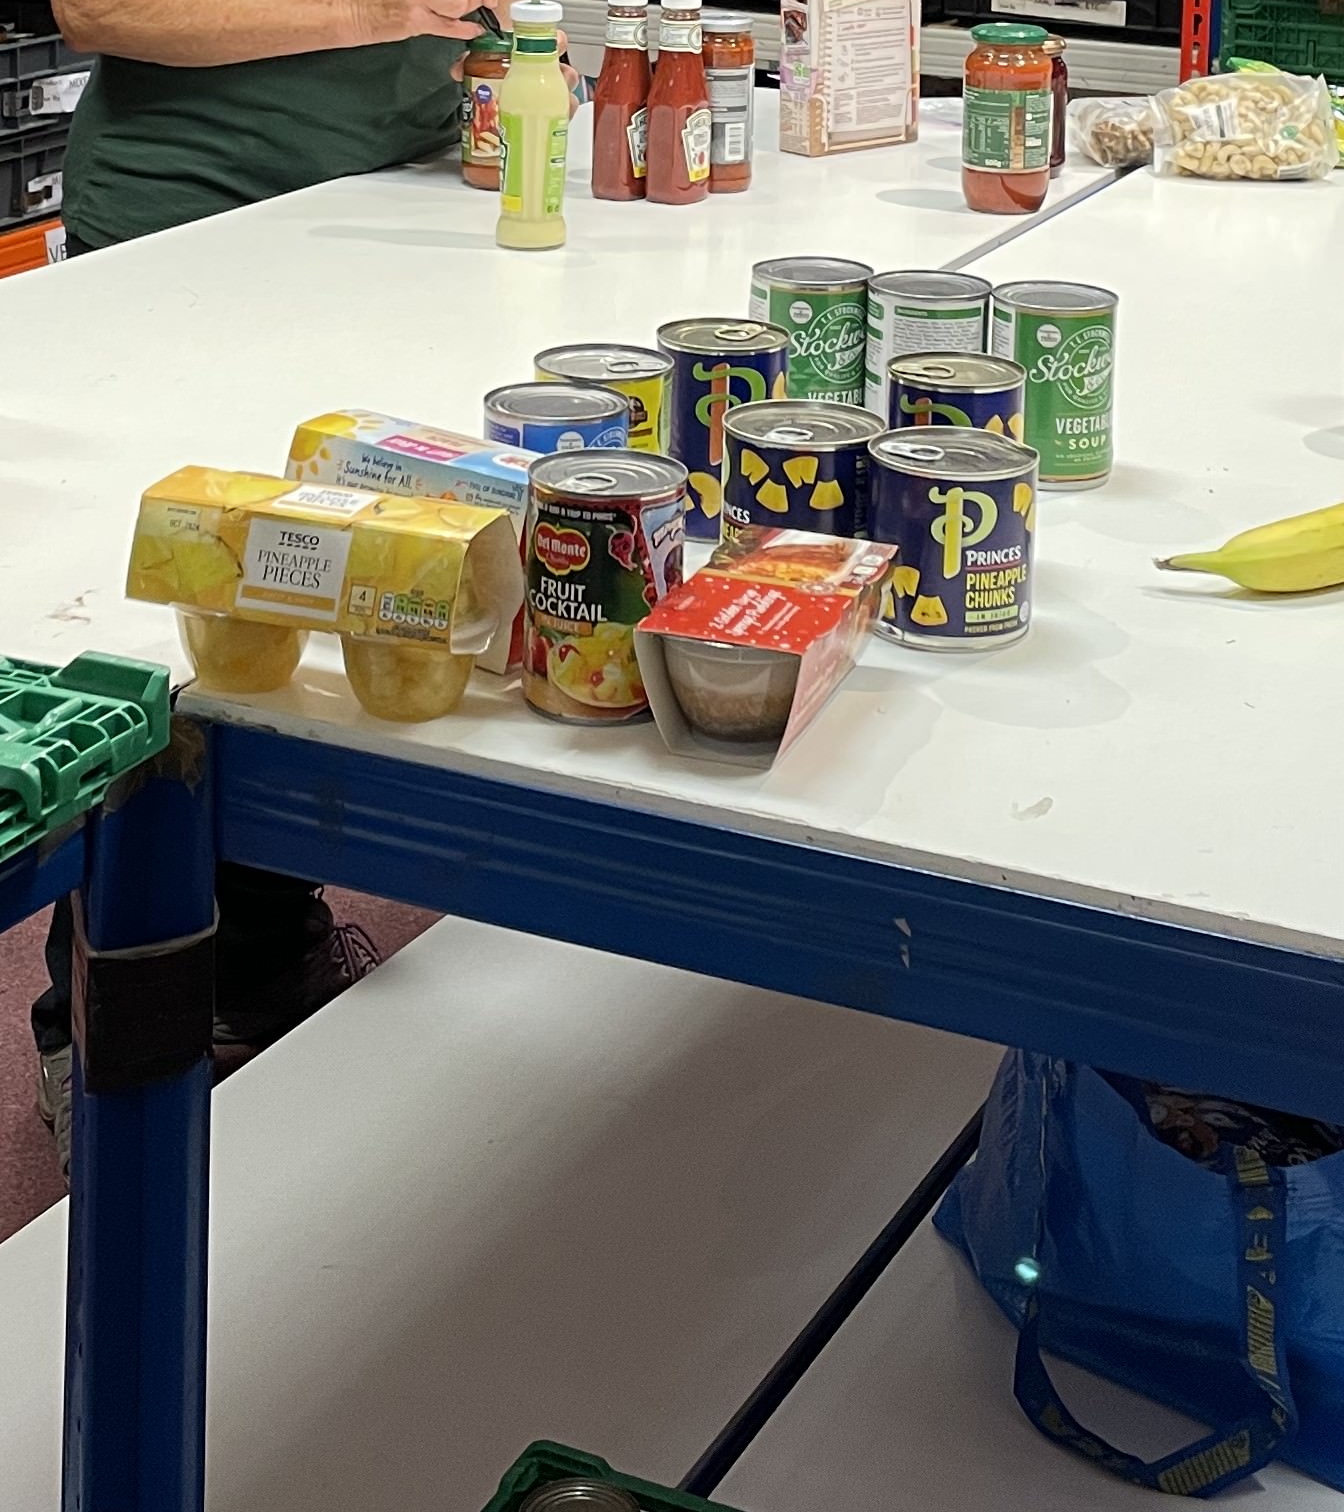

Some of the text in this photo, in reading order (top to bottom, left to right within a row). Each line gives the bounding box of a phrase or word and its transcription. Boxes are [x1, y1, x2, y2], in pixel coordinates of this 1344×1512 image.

[1068, 434, 1106, 450] SOUP
[343, 460, 382, 482] Sunshine
[384, 470, 397, 485] for
[280, 530, 320, 546] TESCO
[537, 533, 587, 558] Del Monte
[257, 549, 332, 573] PINEAPPLE
[965, 545, 1022, 566] PRINCES
[262, 564, 321, 589] PIECES
[966, 563, 1027, 591] PINEAPPLE
[359, 590, 367, 602] 4
[540, 575, 587, 603] FRUIT
[965, 587, 1016, 609] CHUNKS
[528, 588, 608, 622] COCKTAIL
